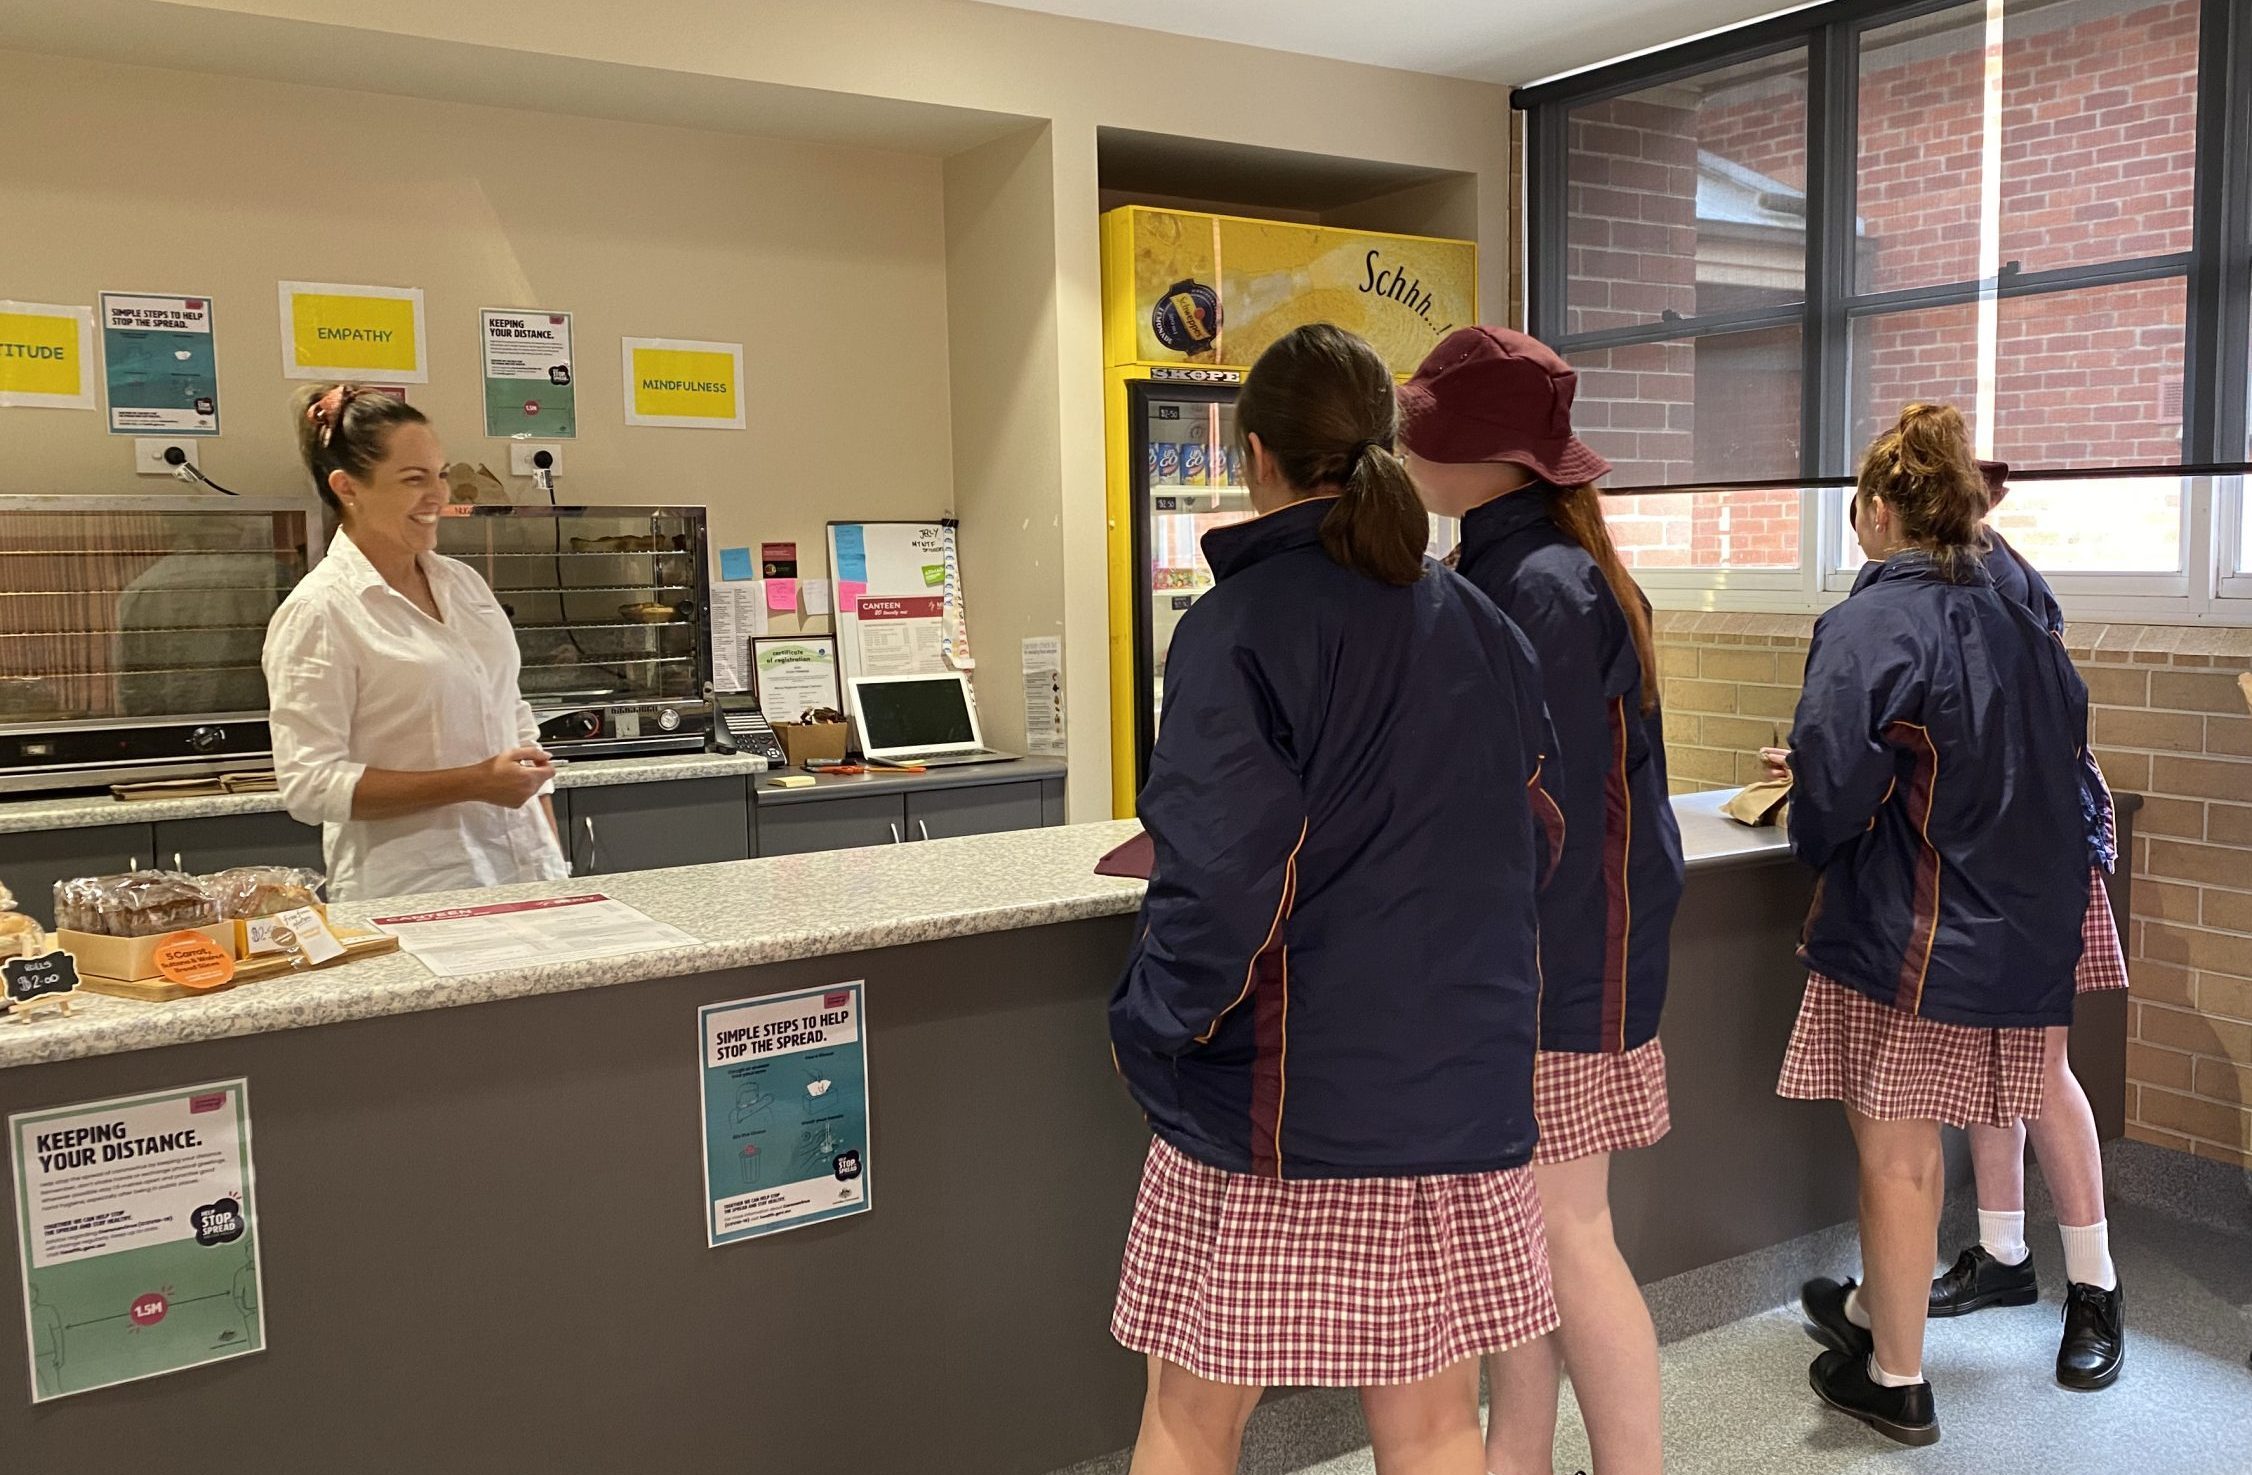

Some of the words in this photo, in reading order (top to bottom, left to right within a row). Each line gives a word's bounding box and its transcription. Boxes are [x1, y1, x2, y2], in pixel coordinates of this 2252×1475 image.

[112, 308, 141, 318] SIMPLE
[144, 309, 168, 319] STEPS
[171, 311, 181, 320] TO
[183, 312, 203, 321] HELP
[112, 317, 133, 326] STOP
[136, 318, 151, 327] THE
[153, 319, 189, 329] SPREAD.
[489, 318, 525, 329] KEEPING
[317, 327, 393, 343] EMPATHY
[490, 328, 513, 338] YOUR
[514, 329, 555, 340] DISTANCE.
[0, 343, 65, 361] ITUDE
[1150, 368, 1240, 382] SKOPE
[642, 379, 727, 393] MINDFULNESS
[862, 602, 901, 610] CANTEEN
[716, 1025, 760, 1046] SIMPLE
[763, 1018, 799, 1037] STEPS
[802, 1015, 817, 1030] TO
[820, 1010, 849, 1027] HELP
[717, 1043, 747, 1061] STOP
[751, 1038, 773, 1054] THE
[776, 1029, 827, 1050] SPREAD.
[37, 1121, 127, 1153] KEEPING
[38, 1147, 97, 1174] YOUR
[102, 1129, 203, 1163] DISTANCE.
[838, 1158, 856, 1169] STOP
[201, 1211, 232, 1228] STOP
[202, 1221, 236, 1236] SPREAD
